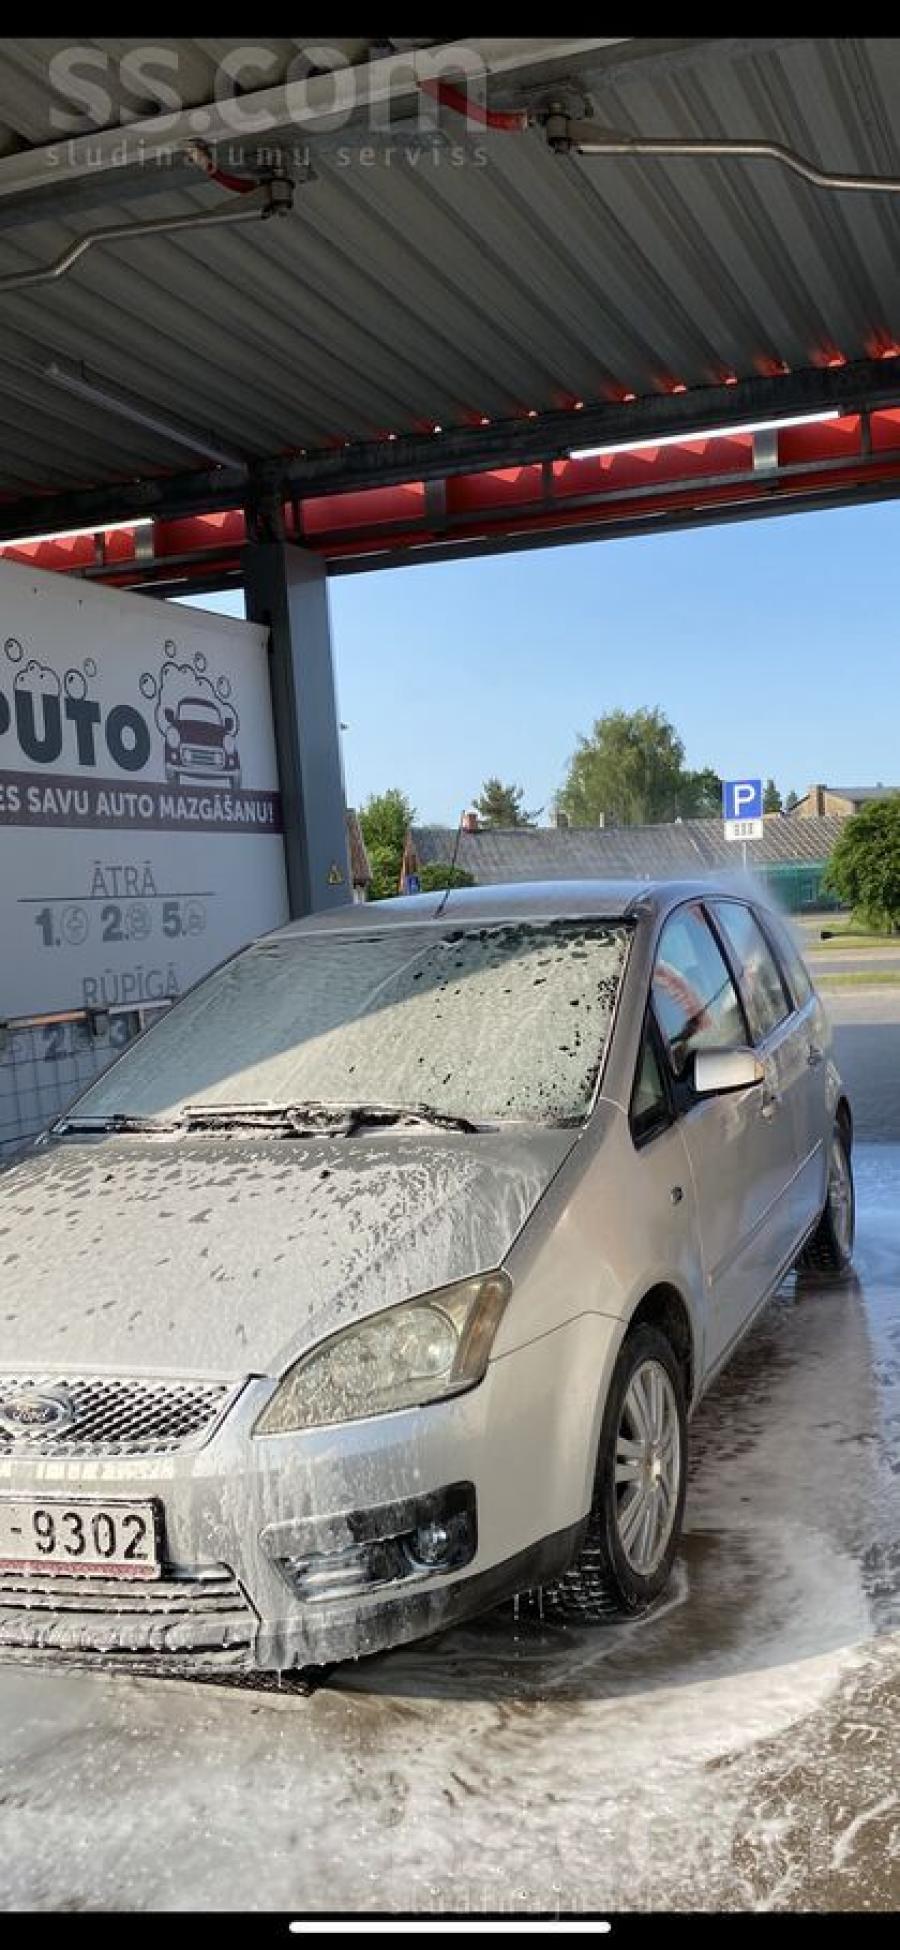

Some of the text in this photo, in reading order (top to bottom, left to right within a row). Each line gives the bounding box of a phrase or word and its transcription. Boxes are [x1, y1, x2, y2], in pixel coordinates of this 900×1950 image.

[0, 689, 151, 772] UTO
[27, 786, 89, 816] SAVU
[96, 792, 153, 819] AUTO
[160, 794, 275, 824] MAZGĀŠANU!
[734, 783, 755, 817] P
[90, 861, 157, 897] ĀTRĀ
